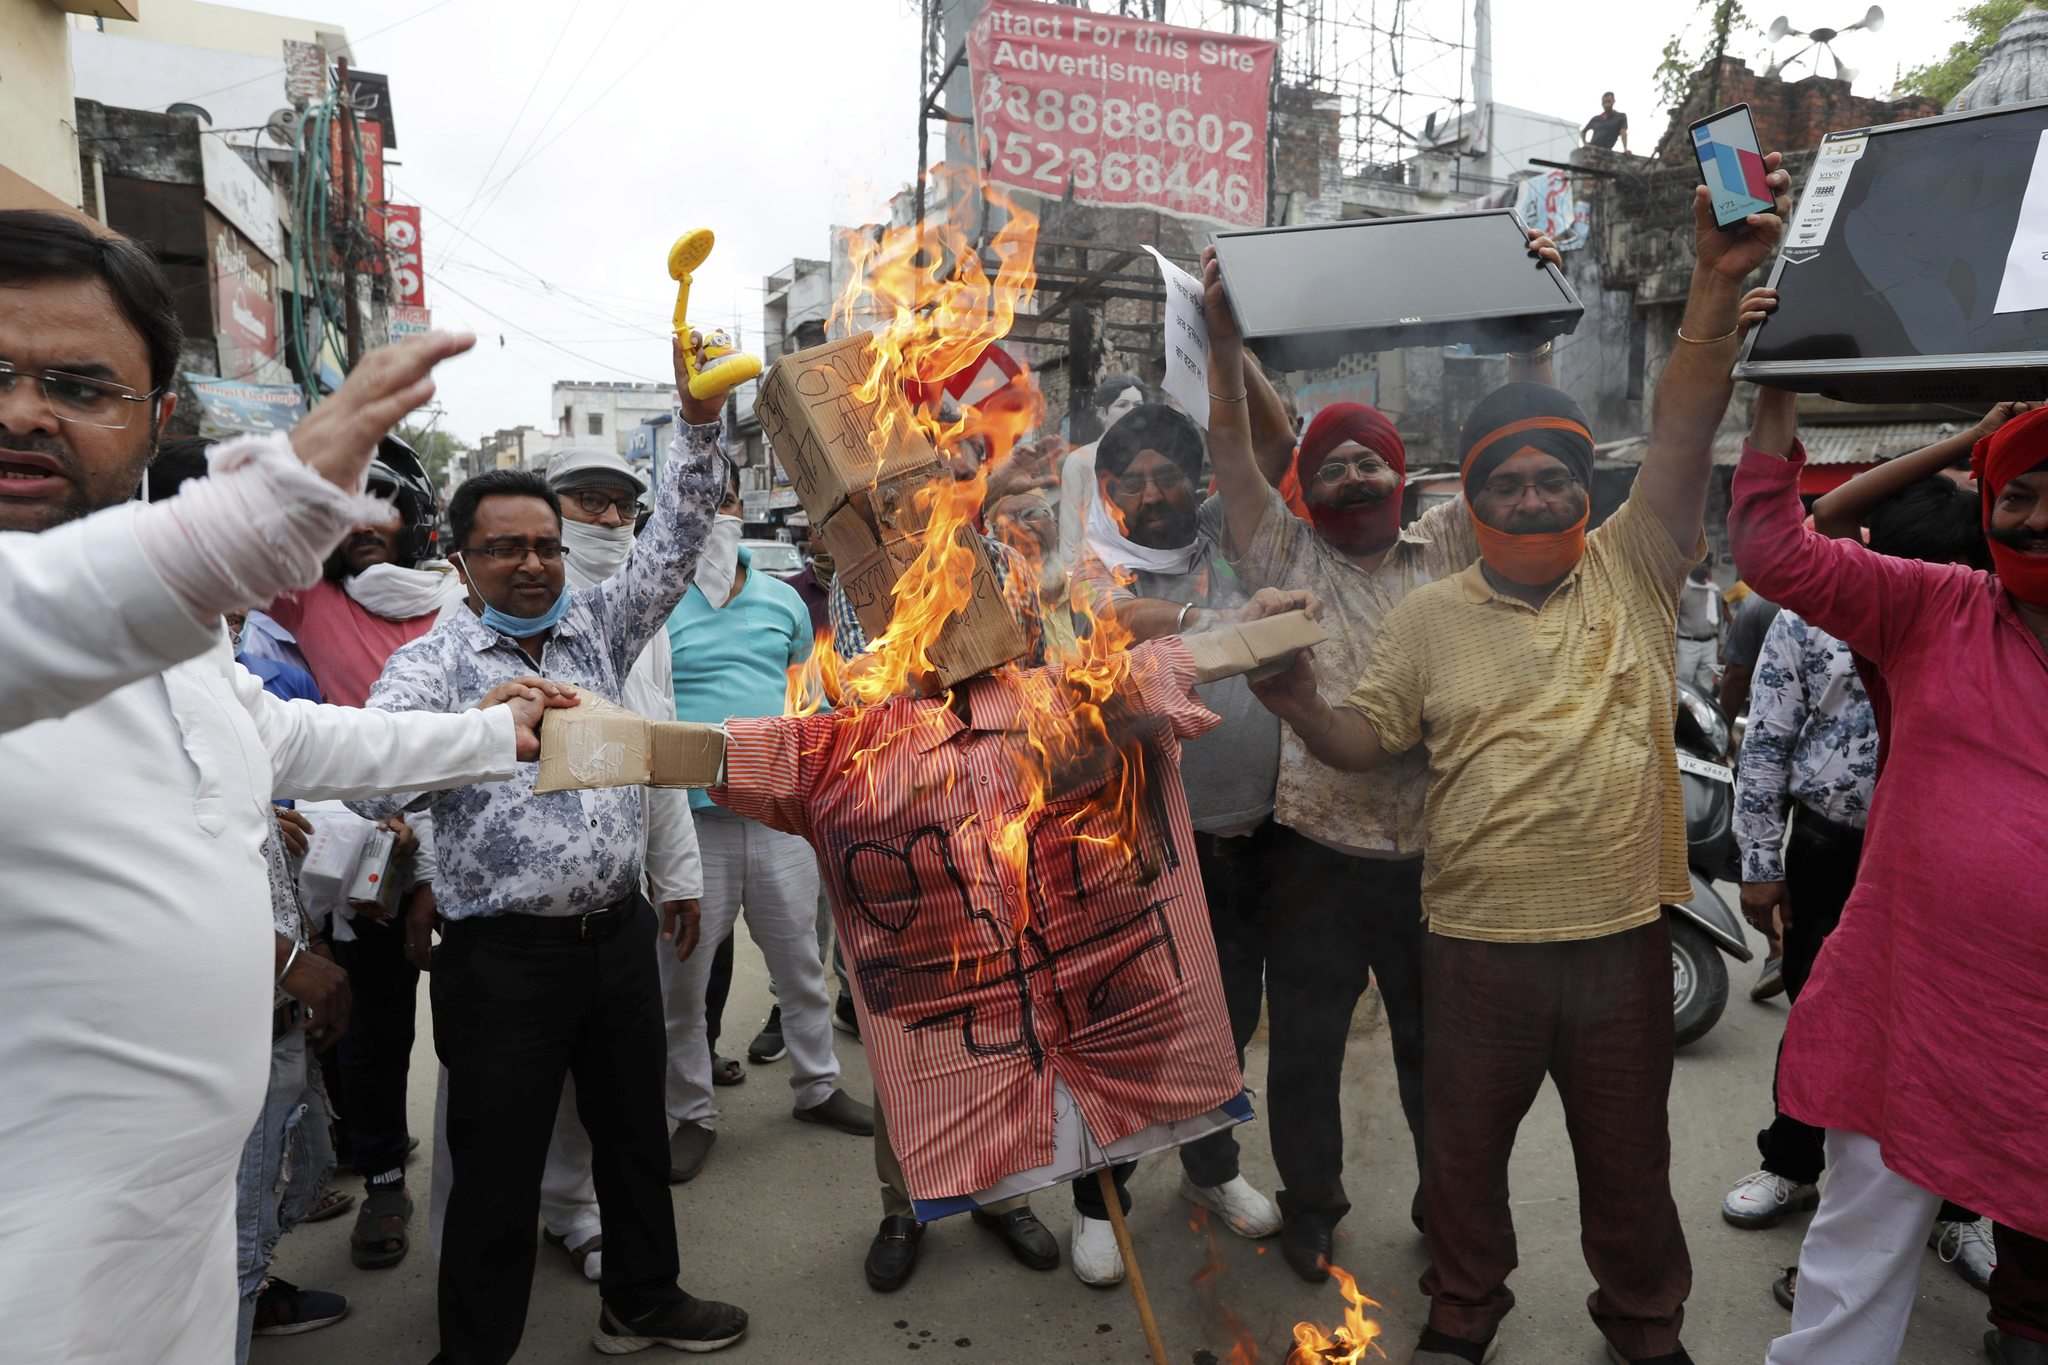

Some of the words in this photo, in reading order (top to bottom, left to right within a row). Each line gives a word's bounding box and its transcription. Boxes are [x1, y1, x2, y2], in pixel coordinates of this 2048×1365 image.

[993, 41, 1203, 95] Advertisment
[1073, 17, 1126, 49] For
[1199, 40, 1255, 73] Site
